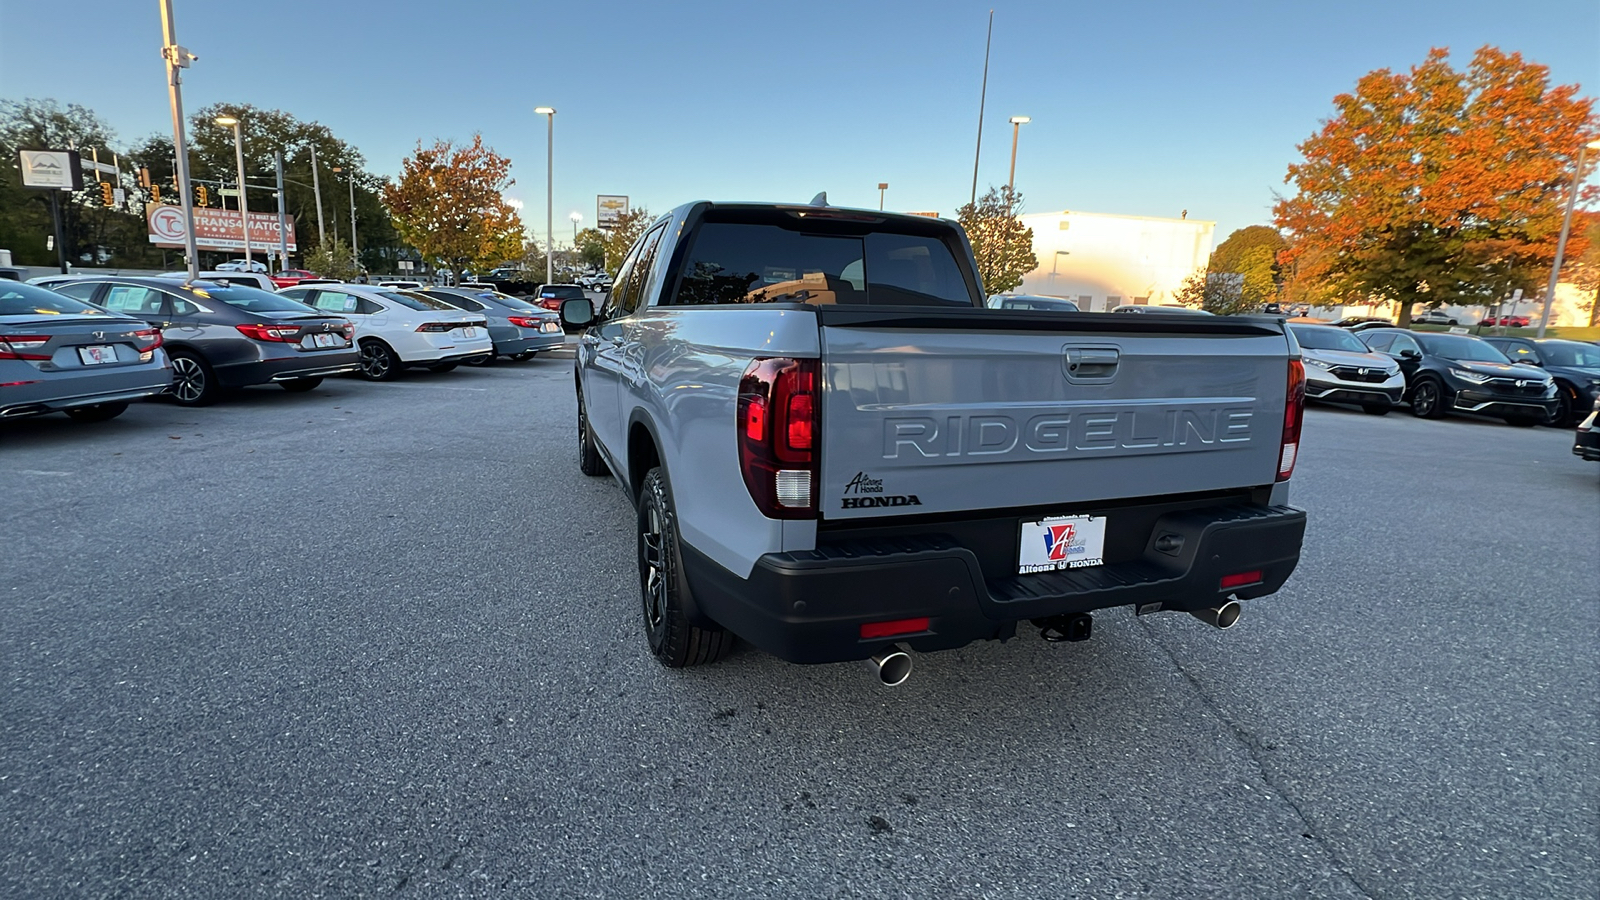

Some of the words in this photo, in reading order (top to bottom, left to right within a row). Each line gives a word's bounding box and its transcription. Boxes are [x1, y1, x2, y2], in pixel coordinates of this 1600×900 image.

[230, 228, 293, 238] CURCH
[882, 406, 1254, 460] RIDGELINE
[860, 485, 883, 493] Honda
[841, 495, 922, 509] HONDA
[1019, 563, 1055, 574] Altoona
[1069, 558, 1104, 568] HONDA
